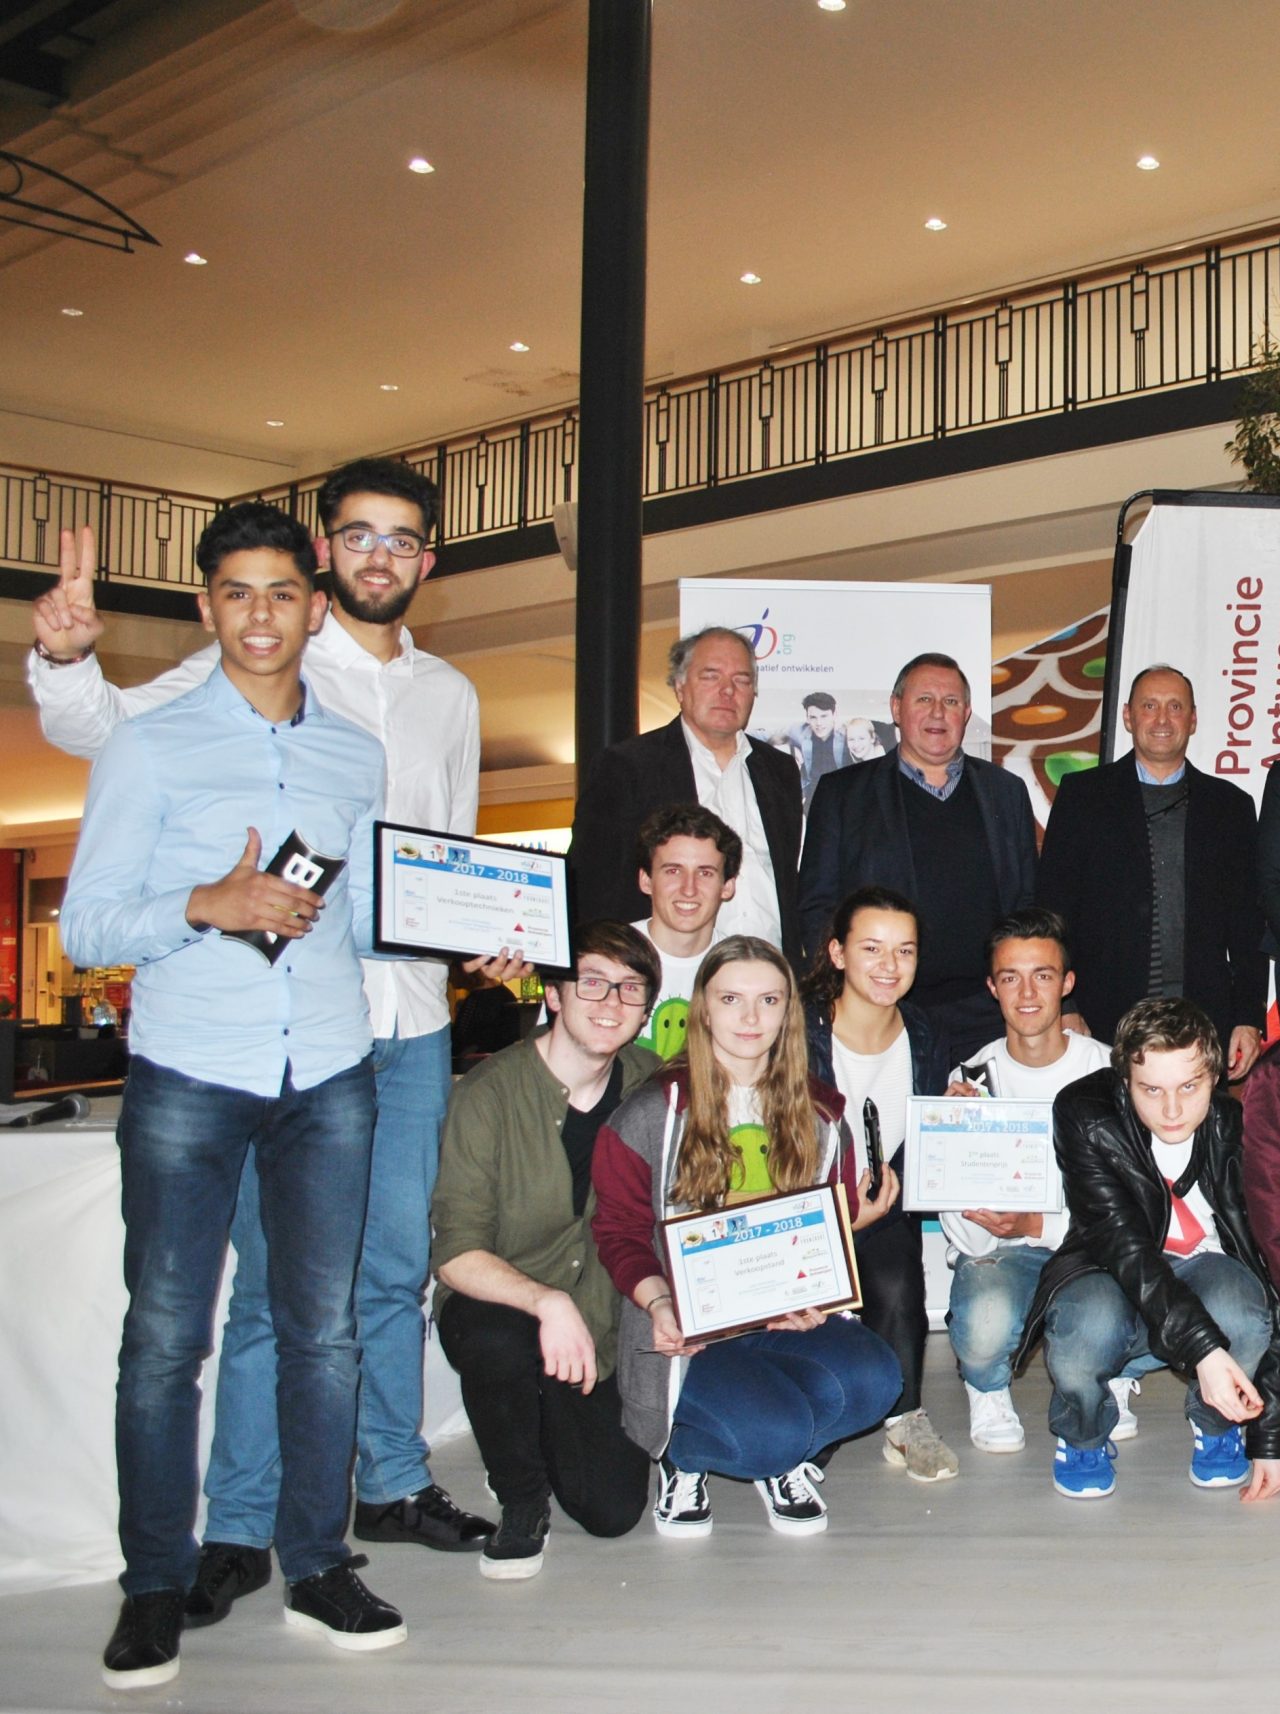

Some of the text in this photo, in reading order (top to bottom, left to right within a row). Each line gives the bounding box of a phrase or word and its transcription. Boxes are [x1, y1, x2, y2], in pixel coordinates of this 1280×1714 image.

[757, 664, 834, 673] atief ontwikkelen
[1215, 576, 1263, 774] Provincie
[453, 863, 485, 876] 2017
[497, 870, 529, 884] 2018
[472, 891, 498, 902] plaats
[437, 897, 514, 914] Verkooptechnieken
[968, 1122, 993, 1131] 2017
[1003, 1122, 1029, 1132] 2018
[733, 1227, 762, 1242] 2017
[774, 1217, 803, 1232] 2018
[757, 1251, 778, 1262] plaats
